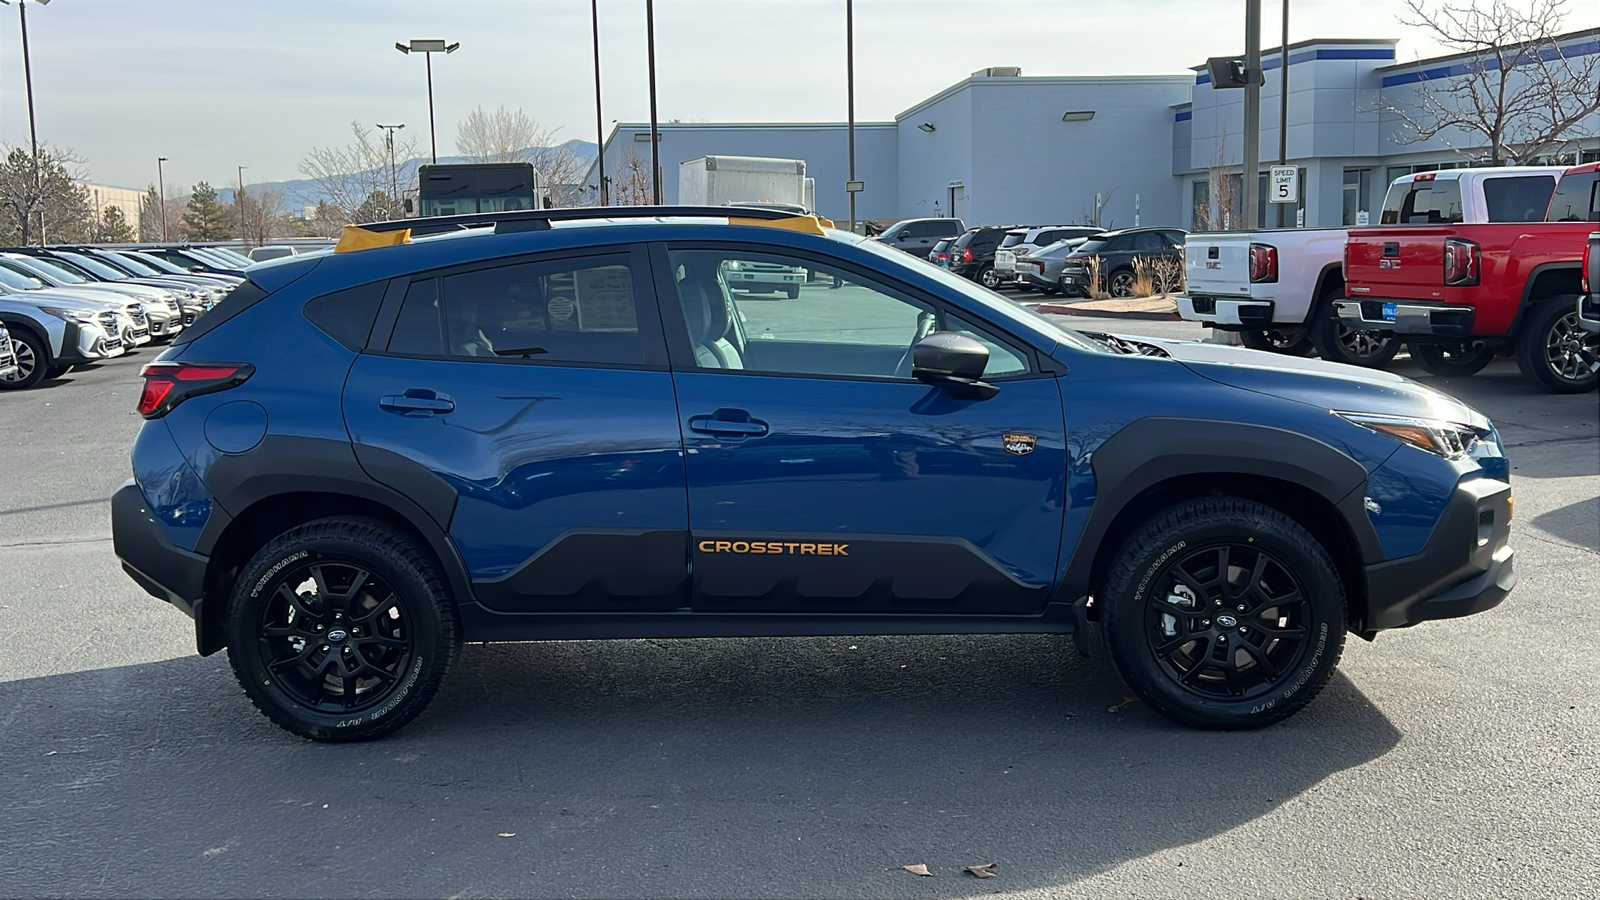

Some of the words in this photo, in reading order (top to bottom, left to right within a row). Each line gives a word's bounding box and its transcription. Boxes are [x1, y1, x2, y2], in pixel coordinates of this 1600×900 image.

[1279, 184, 1289, 198] 5
[698, 540, 850, 557] CROSSTREK
[250, 550, 308, 598] YOKOHAMA
[1134, 540, 1186, 601] YOKOHAMA
[1283, 622, 1329, 699] GEOLANDAR
[370, 655, 424, 721] GEOLANDAR
[336, 717, 363, 728] A/T
[1250, 699, 1276, 714] A/T
